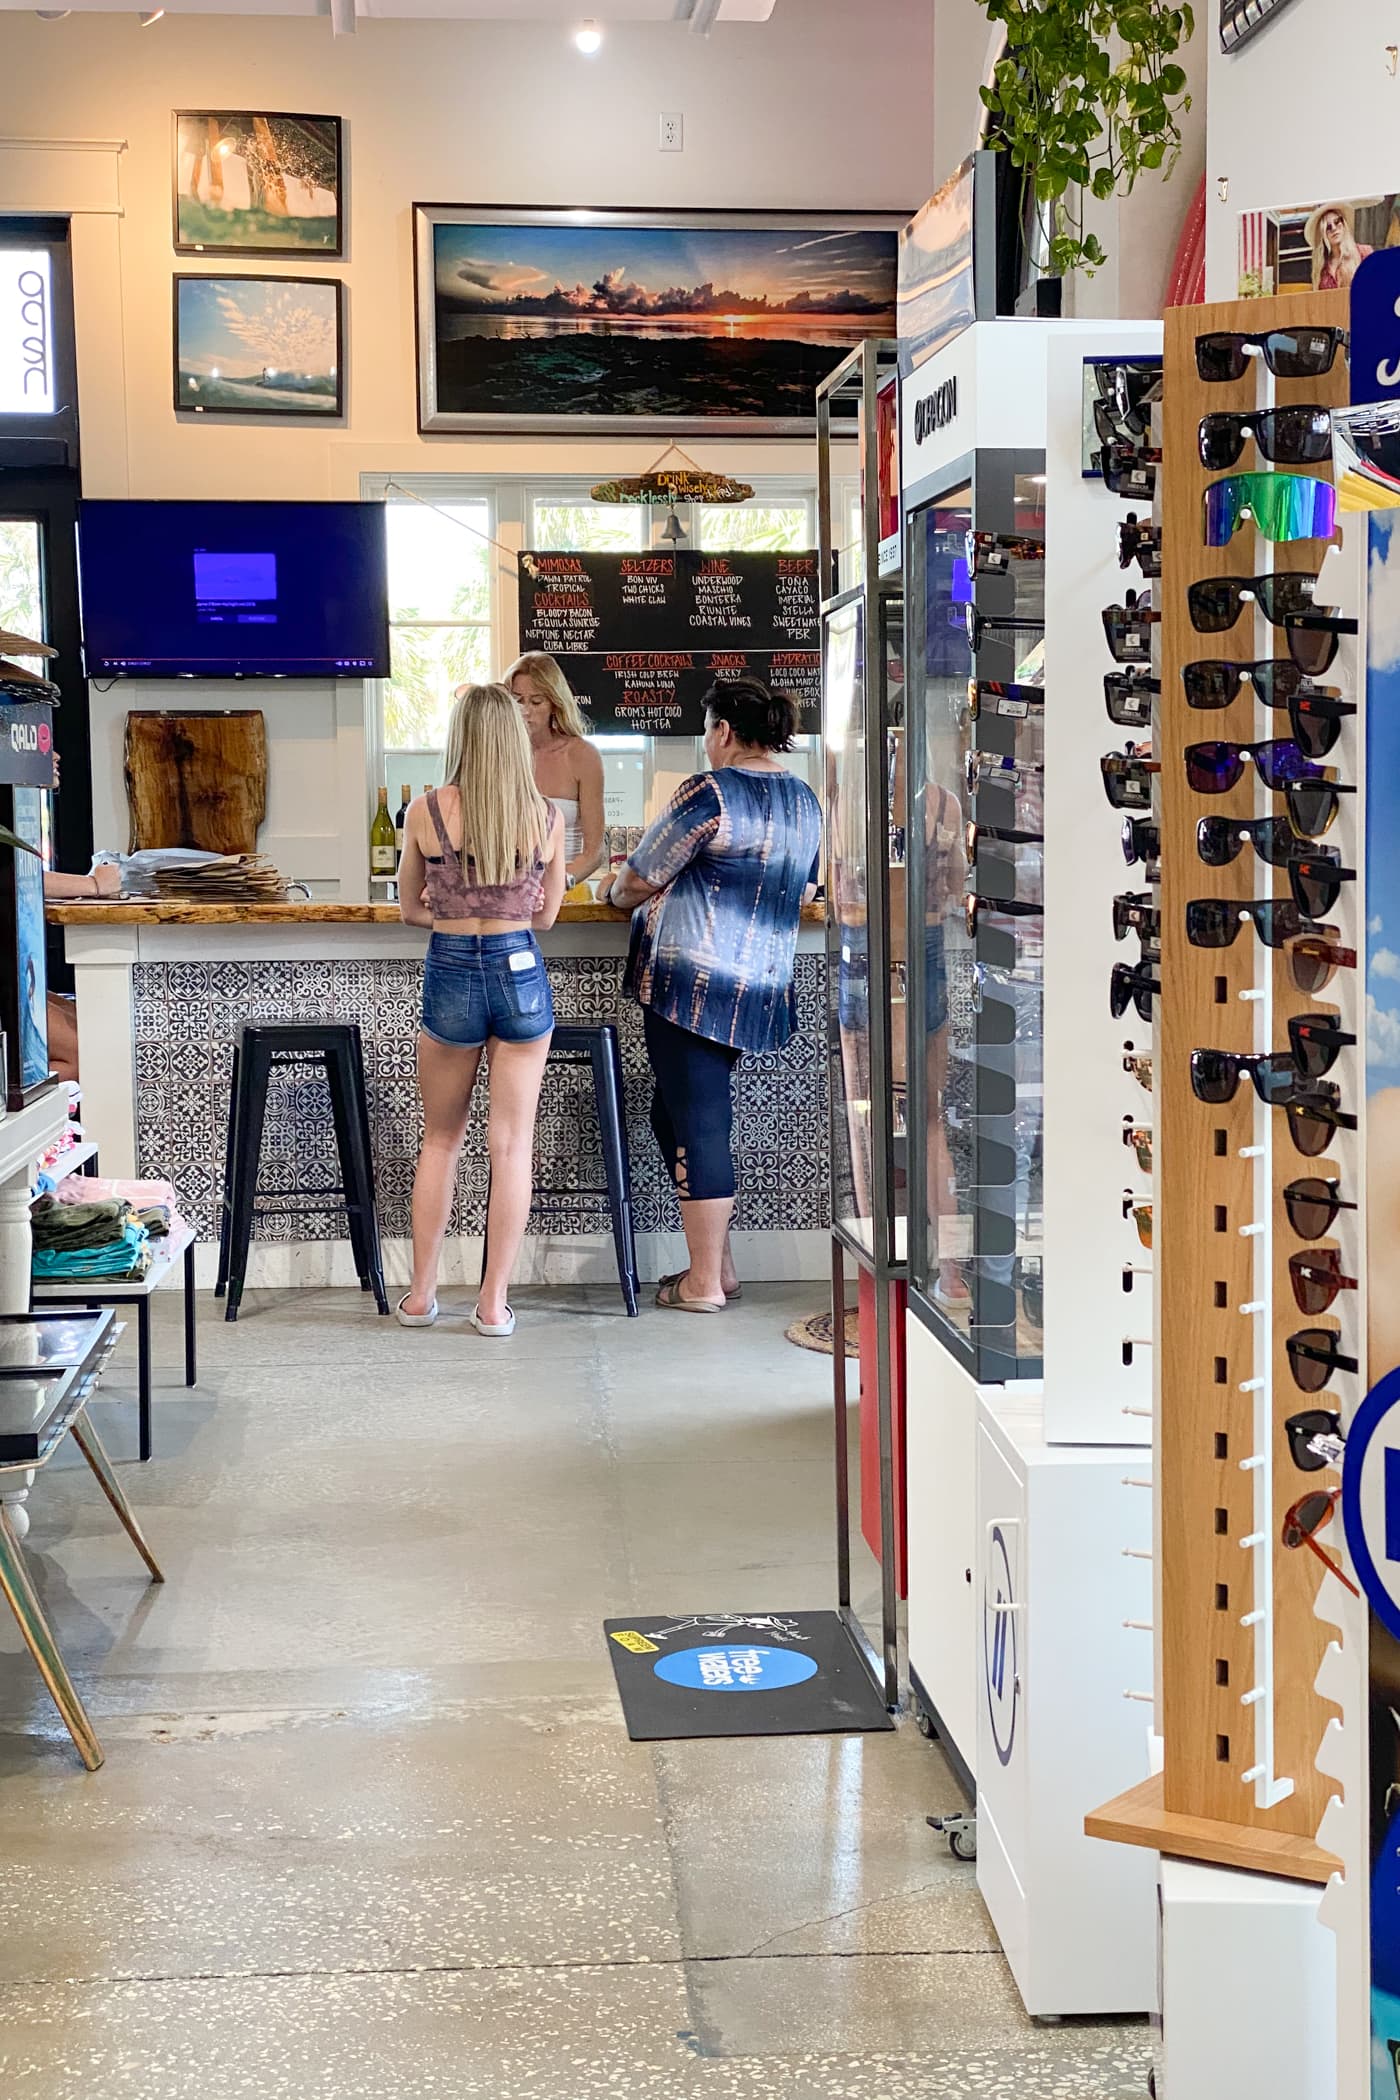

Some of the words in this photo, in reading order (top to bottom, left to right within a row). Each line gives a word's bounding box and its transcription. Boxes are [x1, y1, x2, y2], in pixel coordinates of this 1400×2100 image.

[537, 558, 582, 571] MIMOSAS
[621, 559, 673, 573] SELTZERS
[701, 559, 730, 573] WINE
[778, 559, 813, 573] BEER
[563, 575, 592, 583] PATROL
[627, 576, 643, 584] BON
[645, 576, 658, 584] VIV
[692, 576, 743, 585] UNDERWOOD
[545, 584, 585, 593] TROPICAL
[621, 585, 637, 594] TWO
[638, 584, 665, 594] CHICKS
[698, 586, 734, 594] MASCHIO
[775, 585, 809, 595] CAYACO
[534, 592, 590, 606] COCKTAILS
[622, 595, 647, 604] WHITE
[648, 595, 666, 604] CLAW
[695, 594, 742, 605] BONTERRA
[778, 594, 815, 605] IMPERIAL
[536, 609, 567, 618] BLOODY
[569, 609, 593, 617] BACON
[698, 605, 737, 615] RIUNITE
[782, 606, 814, 616] STELLA
[532, 618, 567, 628] TEQUILA
[568, 617, 600, 628] SUNRISE
[689, 615, 728, 627] COASTAL
[729, 616, 751, 627] VINES
[525, 629, 560, 640] NEPTUNE
[563, 629, 596, 640] NECTAR
[787, 628, 811, 640] PBR
[543, 641, 564, 651] CUBA
[566, 641, 589, 651] LIBRE
[606, 654, 646, 668] COFFEE
[648, 653, 693, 667] COCKTAILS
[711, 653, 746, 666] SNACKS
[614, 670, 637, 679] IRISH
[639, 670, 656, 679] COLD
[657, 670, 679, 678] BREW
[715, 668, 741, 677] JERKY
[770, 668, 788, 677] LOCO
[789, 668, 805, 677] COCO
[625, 680, 655, 689] KAHUNA
[656, 680, 675, 689] LUNA
[770, 678, 794, 687] ALOHA
[623, 689, 676, 703] ROASTY
[614, 706, 646, 718] GROM'S
[647, 706, 664, 718] HOT
[665, 706, 682, 717] COCO
[631, 719, 653, 730] HOT
[653, 719, 671, 730] TEA
[11, 723, 38, 752] QALO
